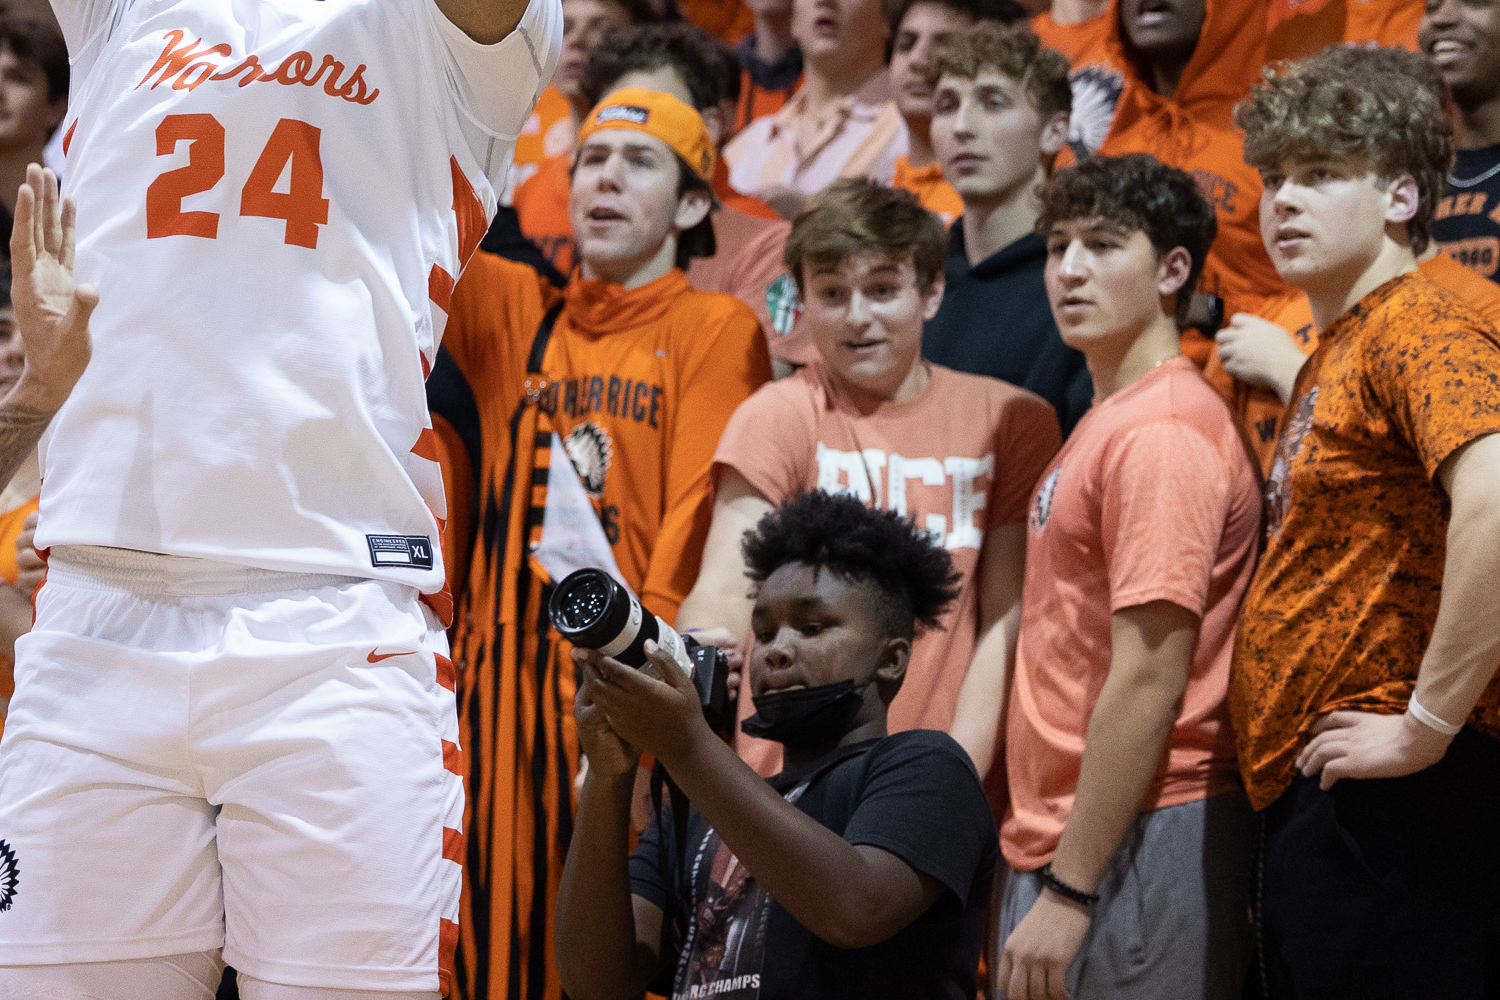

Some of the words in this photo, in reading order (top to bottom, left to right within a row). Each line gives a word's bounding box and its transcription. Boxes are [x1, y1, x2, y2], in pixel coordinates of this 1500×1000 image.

[146, 113, 330, 250] 24
[607, 374, 664, 429] RICE
[412, 546, 429, 559] XL
[707, 973, 761, 998] CHAMPS
